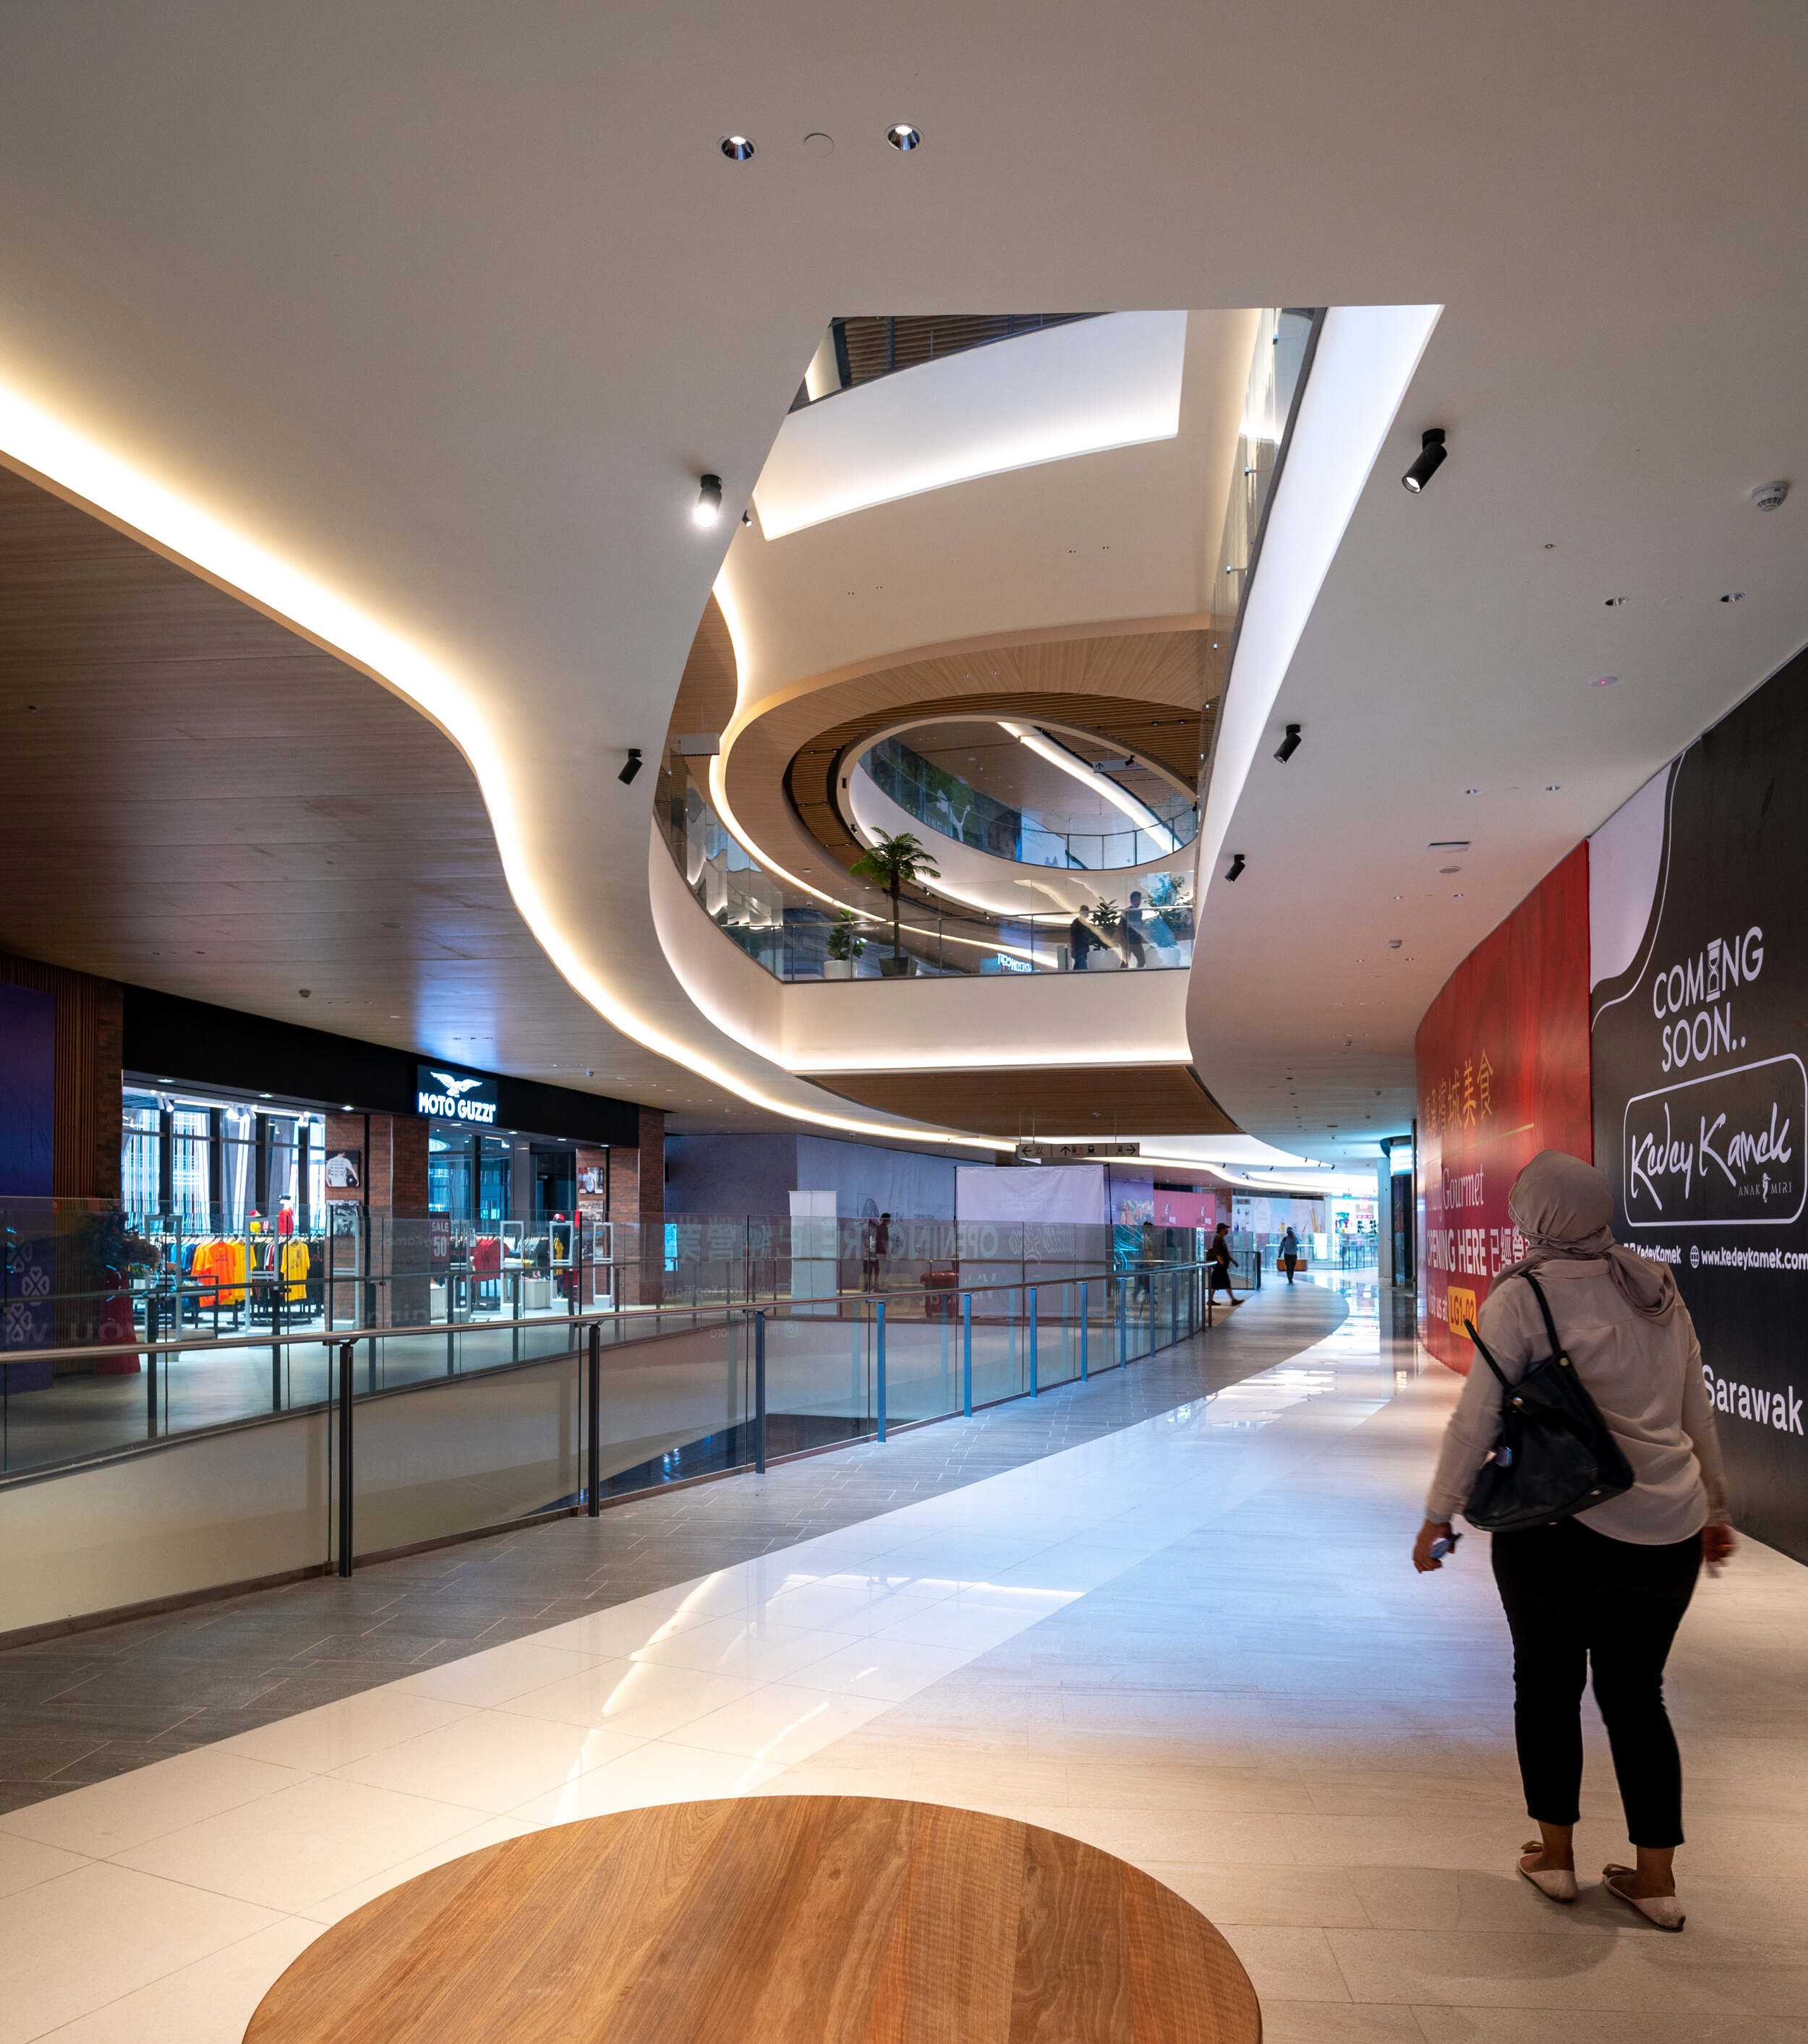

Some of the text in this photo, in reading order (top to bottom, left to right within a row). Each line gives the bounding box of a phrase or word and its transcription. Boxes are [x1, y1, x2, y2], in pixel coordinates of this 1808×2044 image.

[419, 1092, 496, 1123] MOTO GUZZI
[1631, 1102, 1791, 1211] Kedey Kamek
[1442, 1163, 1484, 1210] Gourmet
[1738, 1181, 1792, 1196] ANAK MIRI
[432, 1221, 448, 1232] SALE
[434, 1236, 447, 1257] 50
[1427, 1228, 1487, 1276] OPENING HERE
[1702, 1247, 1808, 1270] www.kedeykamek.com
[1702, 1364, 1804, 1436] Sarawak
